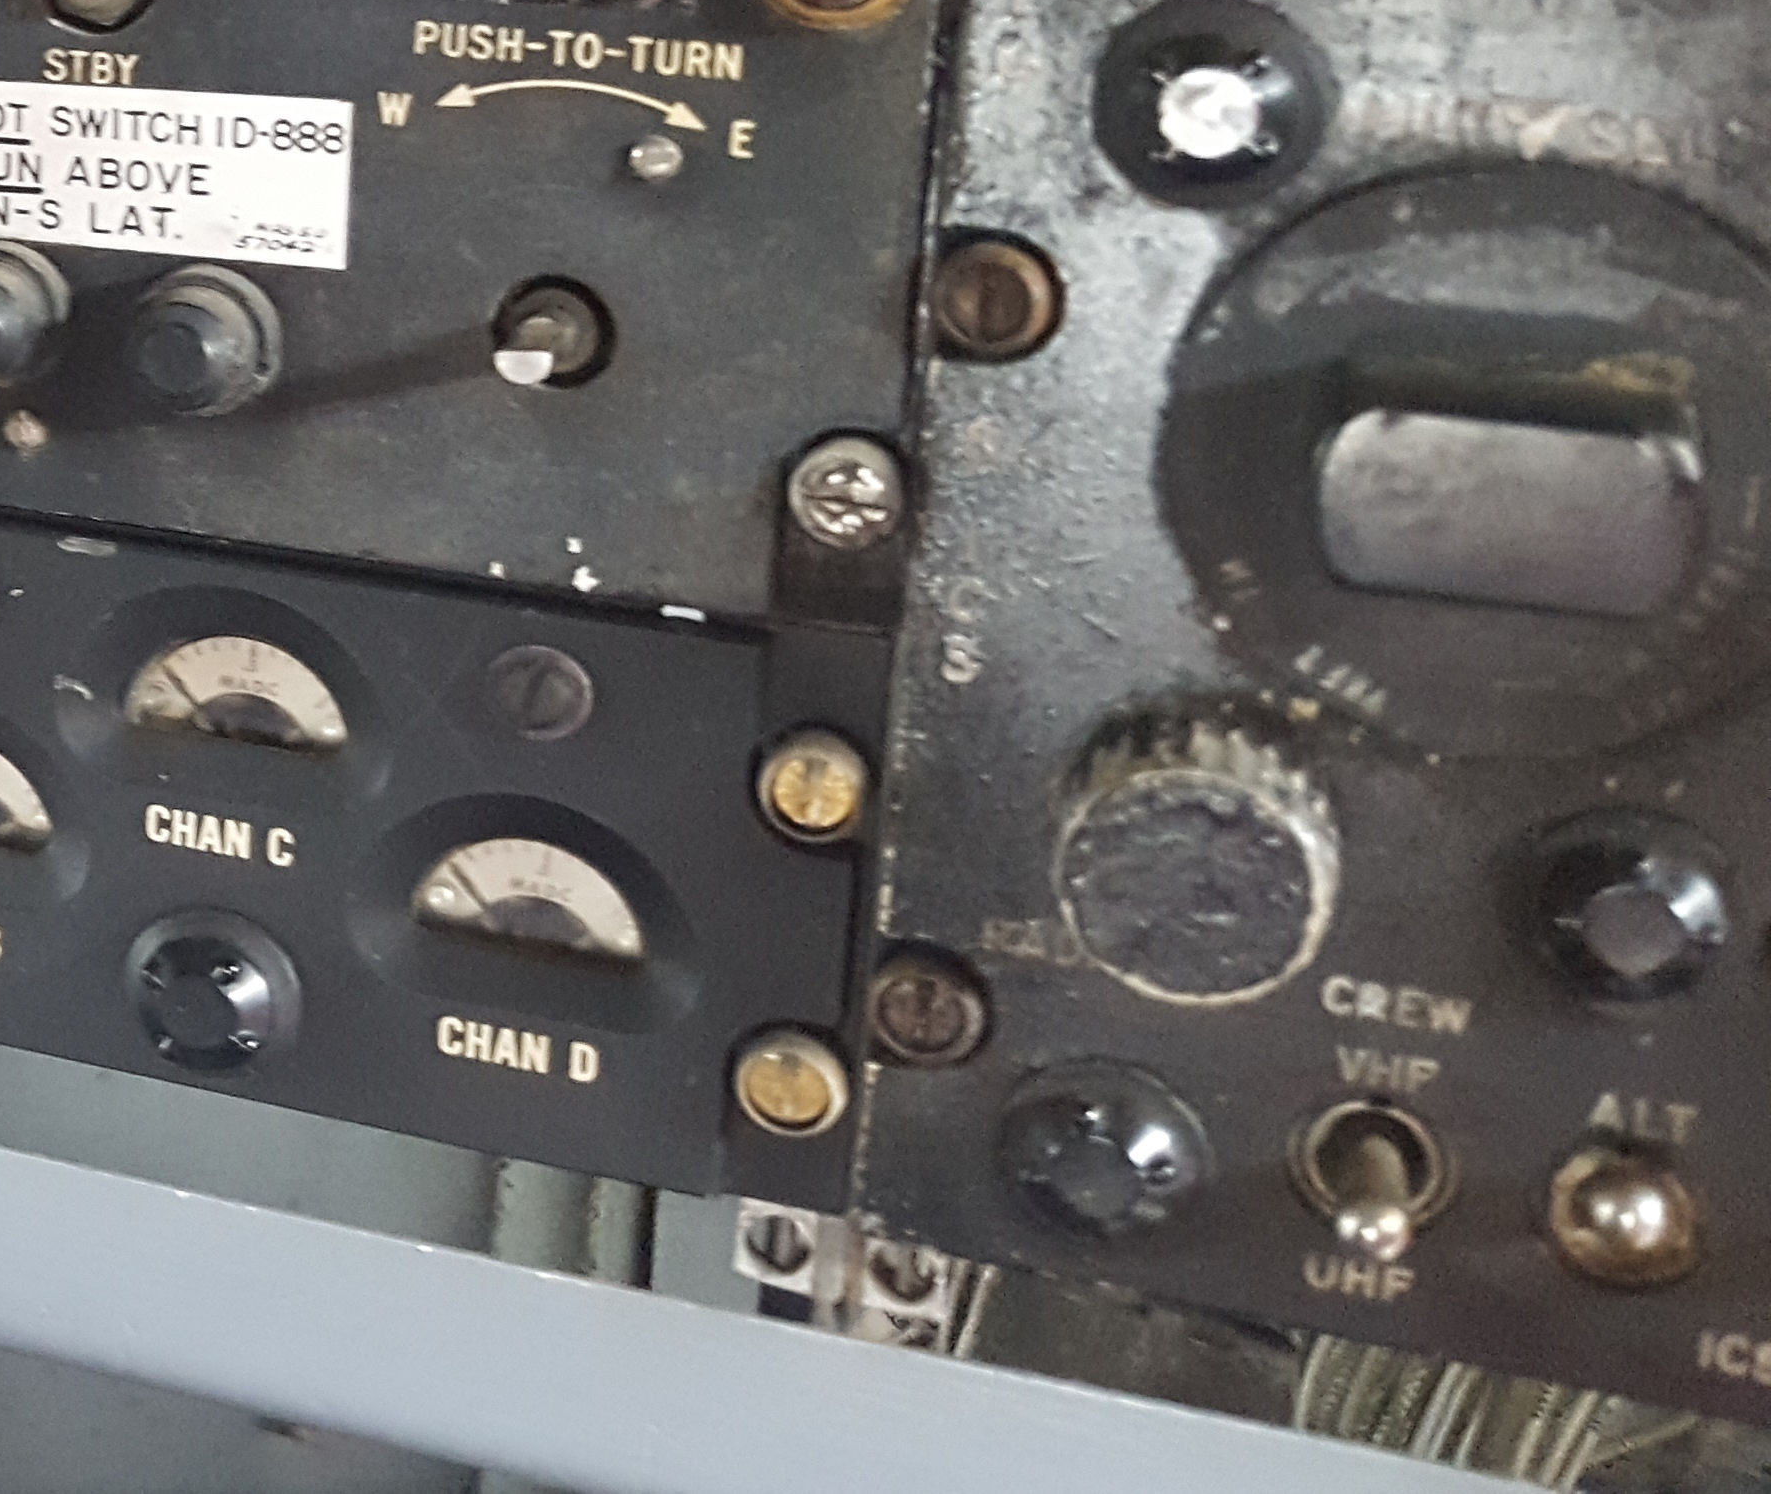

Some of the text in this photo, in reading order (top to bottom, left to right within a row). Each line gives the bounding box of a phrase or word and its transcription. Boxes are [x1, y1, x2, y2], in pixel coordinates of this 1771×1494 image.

[42, 48, 141, 88] STBY
[412, 19, 746, 82] PUSH-TO-TURN
[49, 106, 202, 148] SWITCH
[216, 116, 347, 155] ID-888
[376, 91, 758, 161] W E
[64, 156, 212, 198] ABOVE
[89, 202, 185, 241] LAT.
[143, 803, 296, 868] CHAN C
[1320, 974, 1472, 1037] CREW
[436, 1014, 599, 1083] CHAN D
[1337, 1043, 1440, 1092] VHF
[1587, 1092, 1701, 1146] ALT
[1303, 1254, 1415, 1299] UHF
